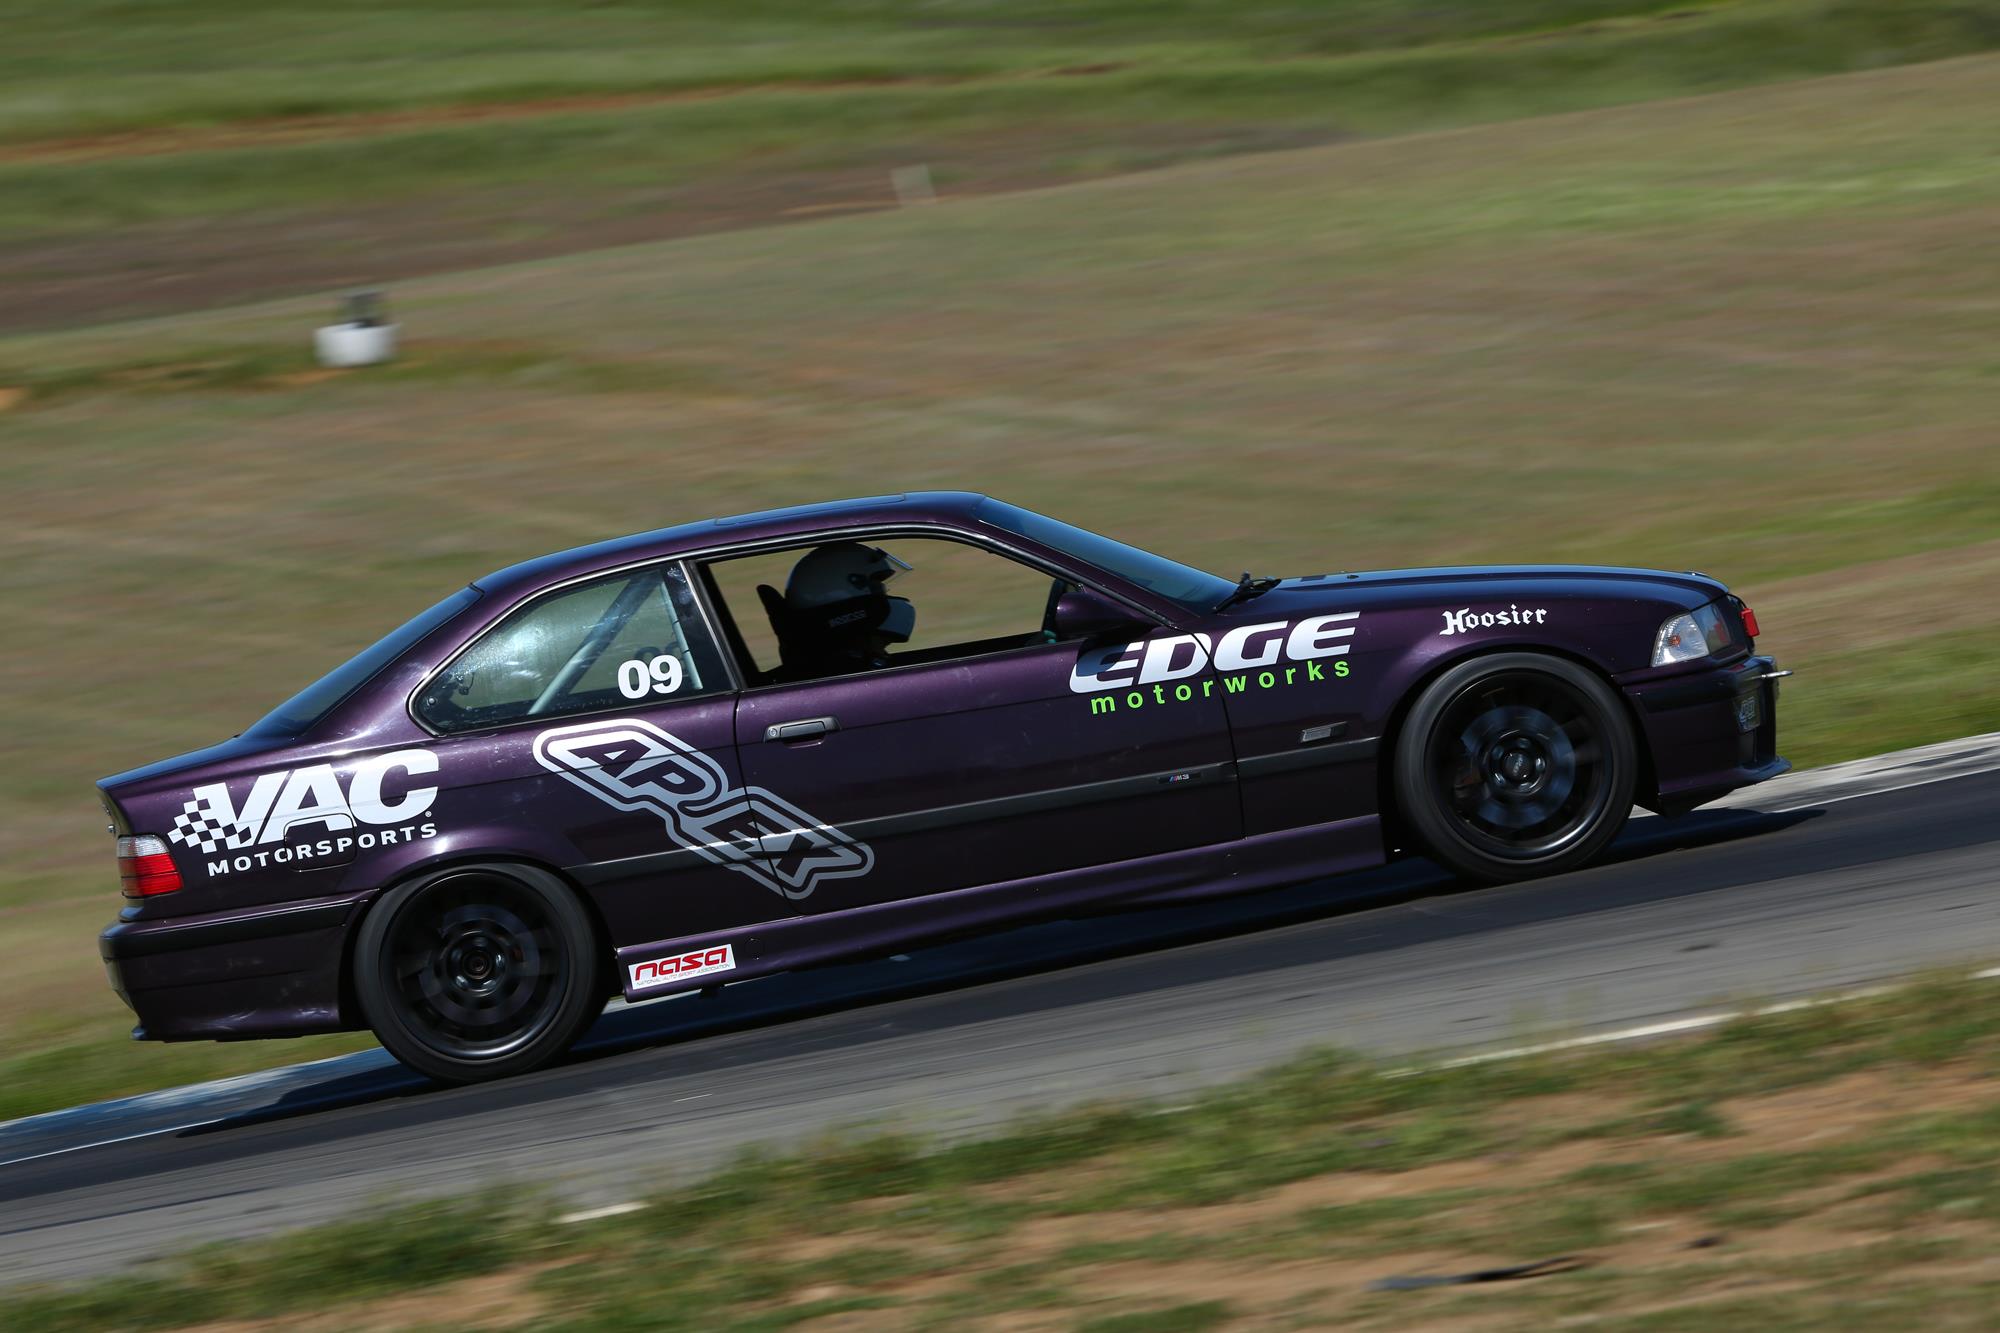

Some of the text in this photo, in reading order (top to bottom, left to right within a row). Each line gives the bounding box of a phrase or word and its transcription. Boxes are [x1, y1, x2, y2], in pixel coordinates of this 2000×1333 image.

[1439, 604, 1547, 635] Hoosier
[618, 655, 682, 699] 09
[1069, 611, 1361, 693] EDGE
[1091, 660, 1350, 714] motorworks
[190, 749, 439, 850] VAC
[207, 823, 437, 877] MOTORSPORTS
